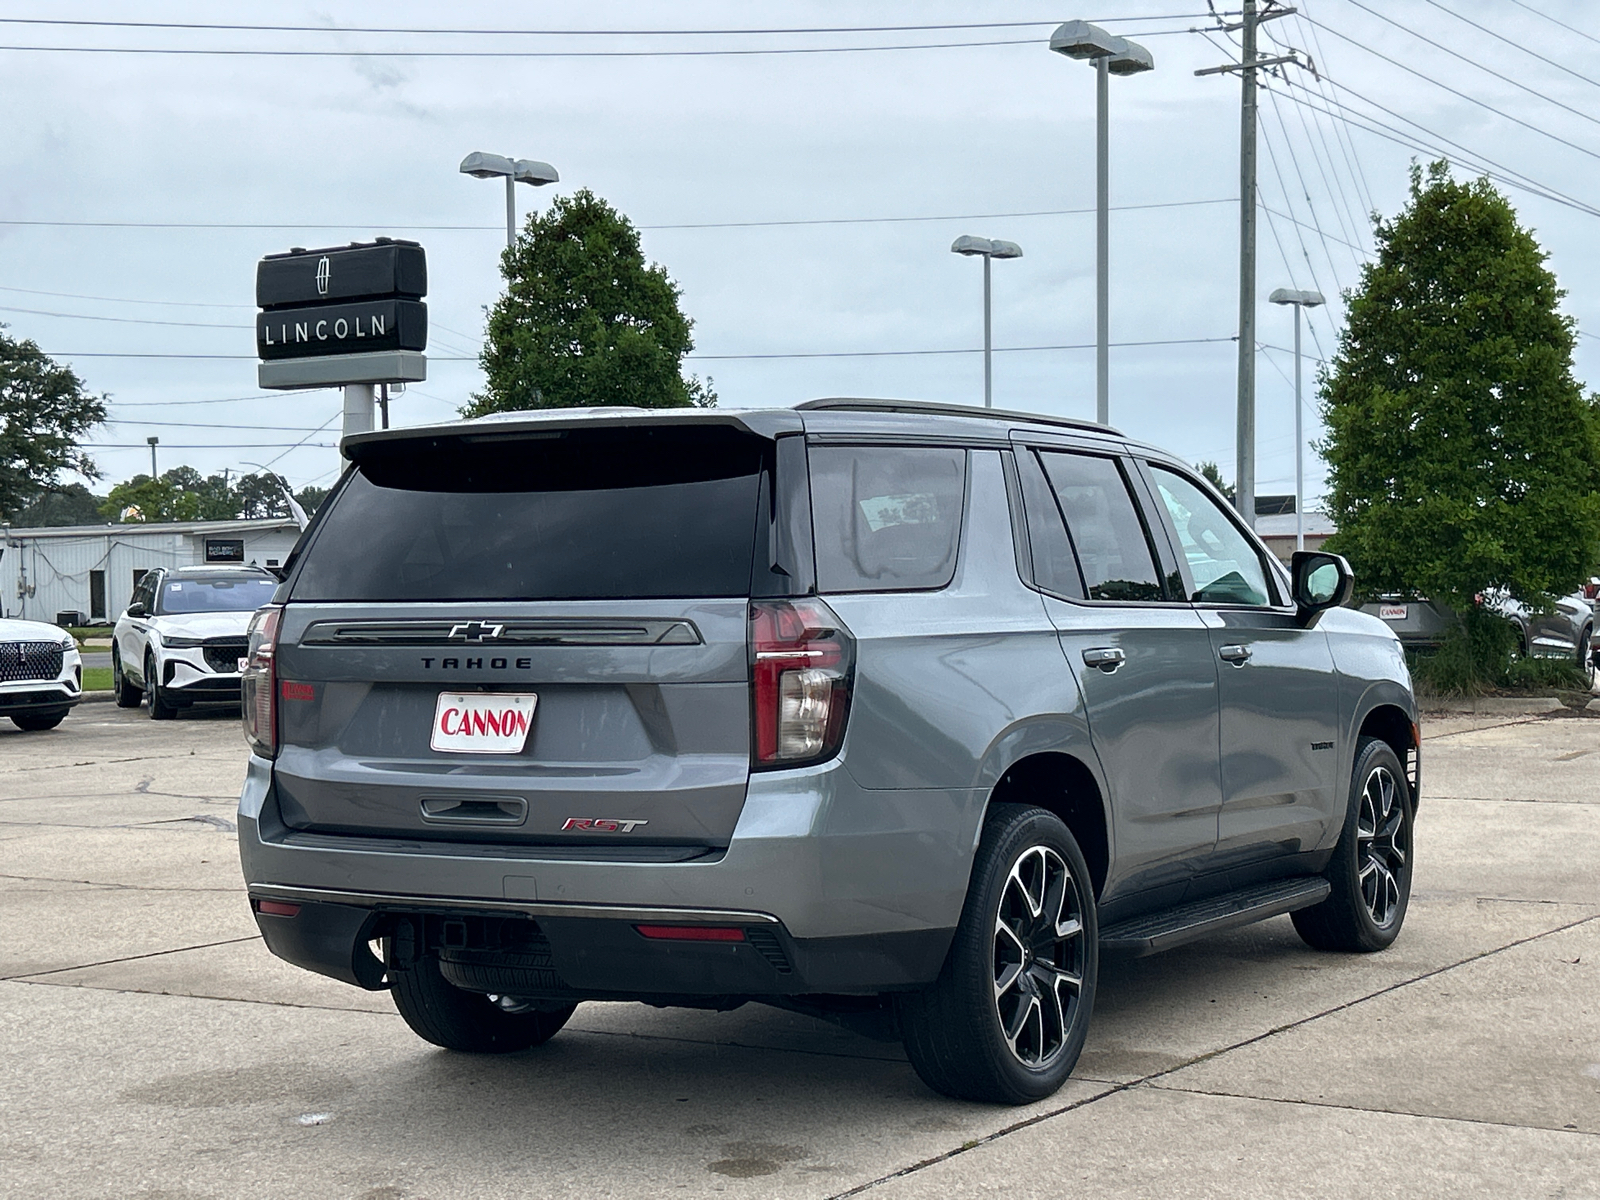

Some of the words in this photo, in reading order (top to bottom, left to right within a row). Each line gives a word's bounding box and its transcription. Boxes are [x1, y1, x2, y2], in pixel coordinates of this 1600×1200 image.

[265, 314, 385, 346] LINCOLN
[421, 657, 532, 669] TAHOE
[441, 708, 531, 737] CANNON
[561, 817, 649, 833] RST
